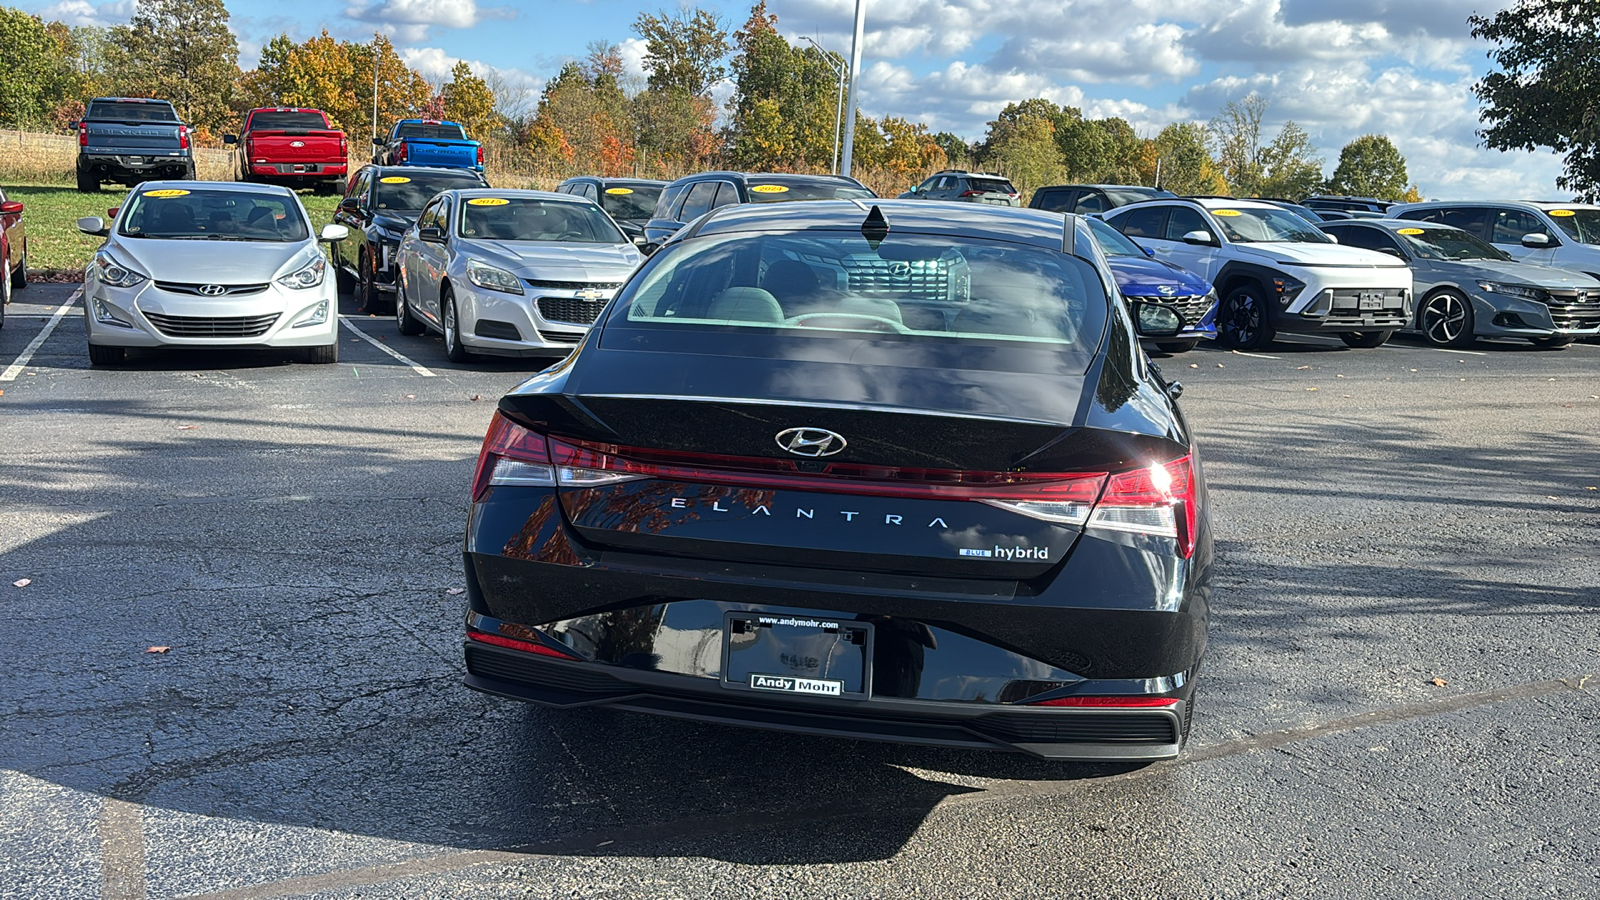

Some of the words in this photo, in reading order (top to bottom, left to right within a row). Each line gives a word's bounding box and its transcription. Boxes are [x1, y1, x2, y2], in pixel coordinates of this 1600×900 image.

[414, 148, 471, 156] CHEVROLET
[671, 497, 948, 529] ELANTRA
[995, 545, 1048, 561] hybrid
[759, 616, 839, 629] www.andymohr.com
[756, 677, 793, 690] Andy
[798, 681, 838, 693] Mohr
